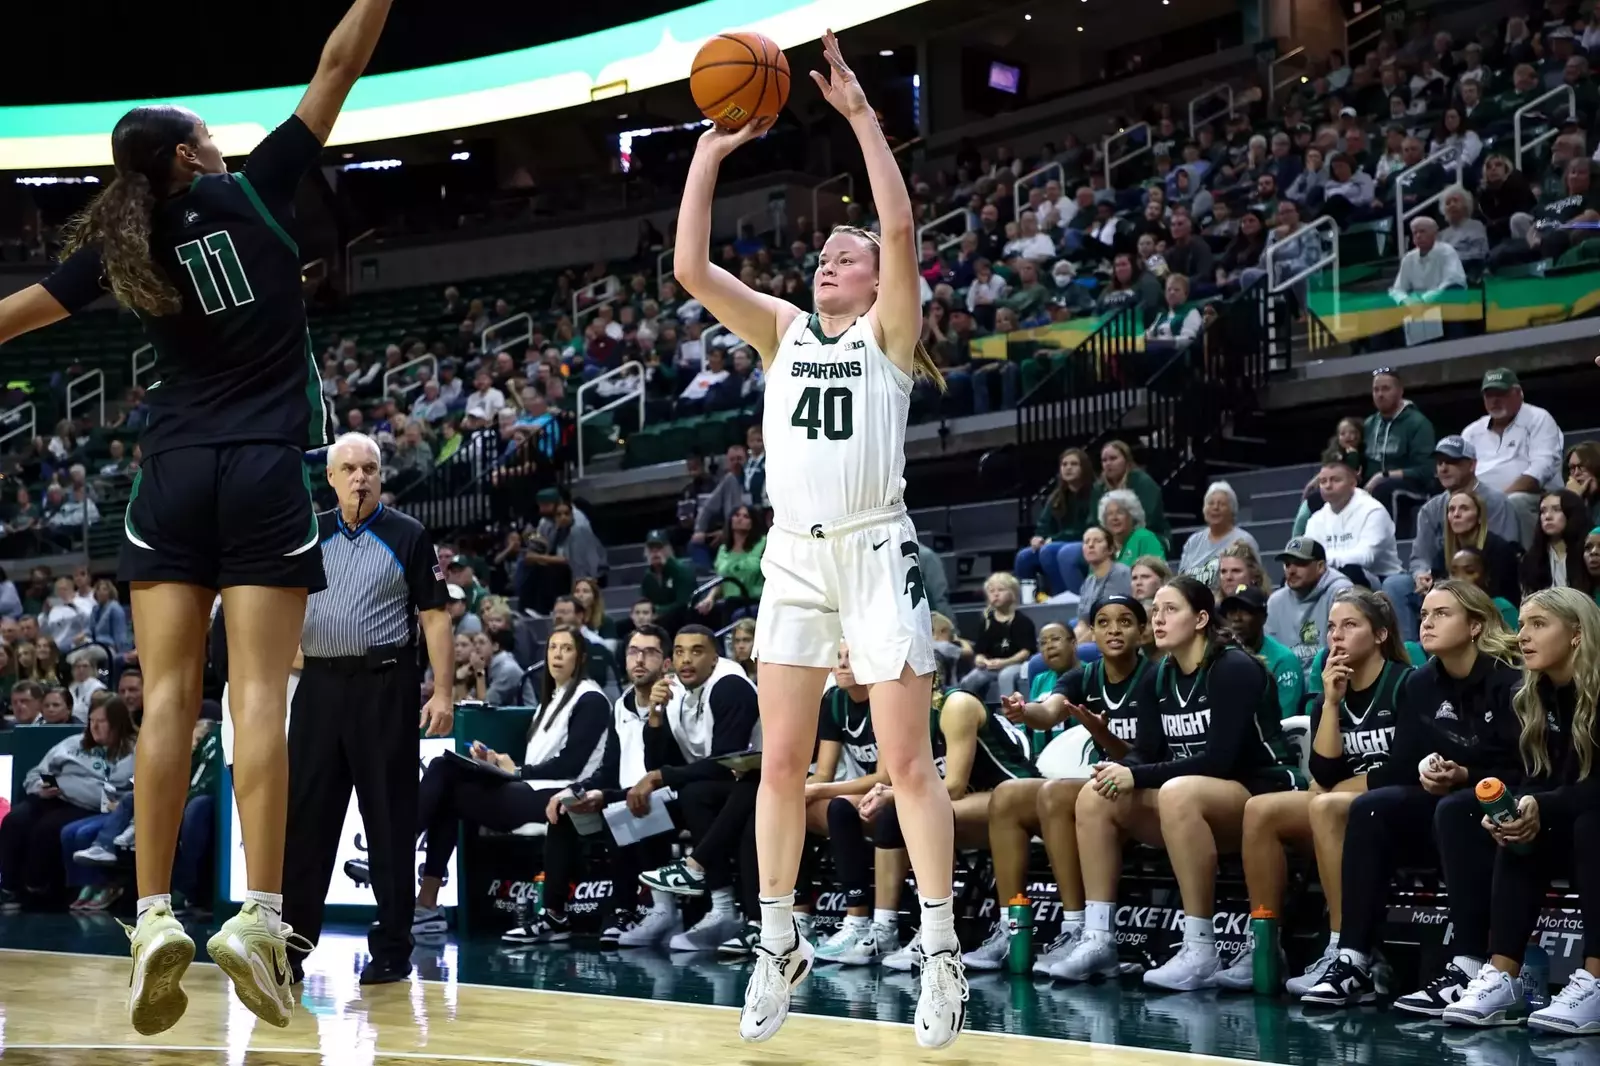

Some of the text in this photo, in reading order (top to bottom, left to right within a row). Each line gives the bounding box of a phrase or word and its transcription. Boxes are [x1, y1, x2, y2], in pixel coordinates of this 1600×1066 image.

[175, 230, 255, 315] 11
[791, 387, 853, 440] 40
[1341, 726, 1396, 755] RIGHT
[488, 879, 538, 901] RCKE
[568, 879, 614, 900] CKET
[1114, 905, 1172, 930] CKET
[1536, 915, 1584, 930] Mortga
[1115, 929, 1148, 946] tgage
[1215, 938, 1248, 955] gage
